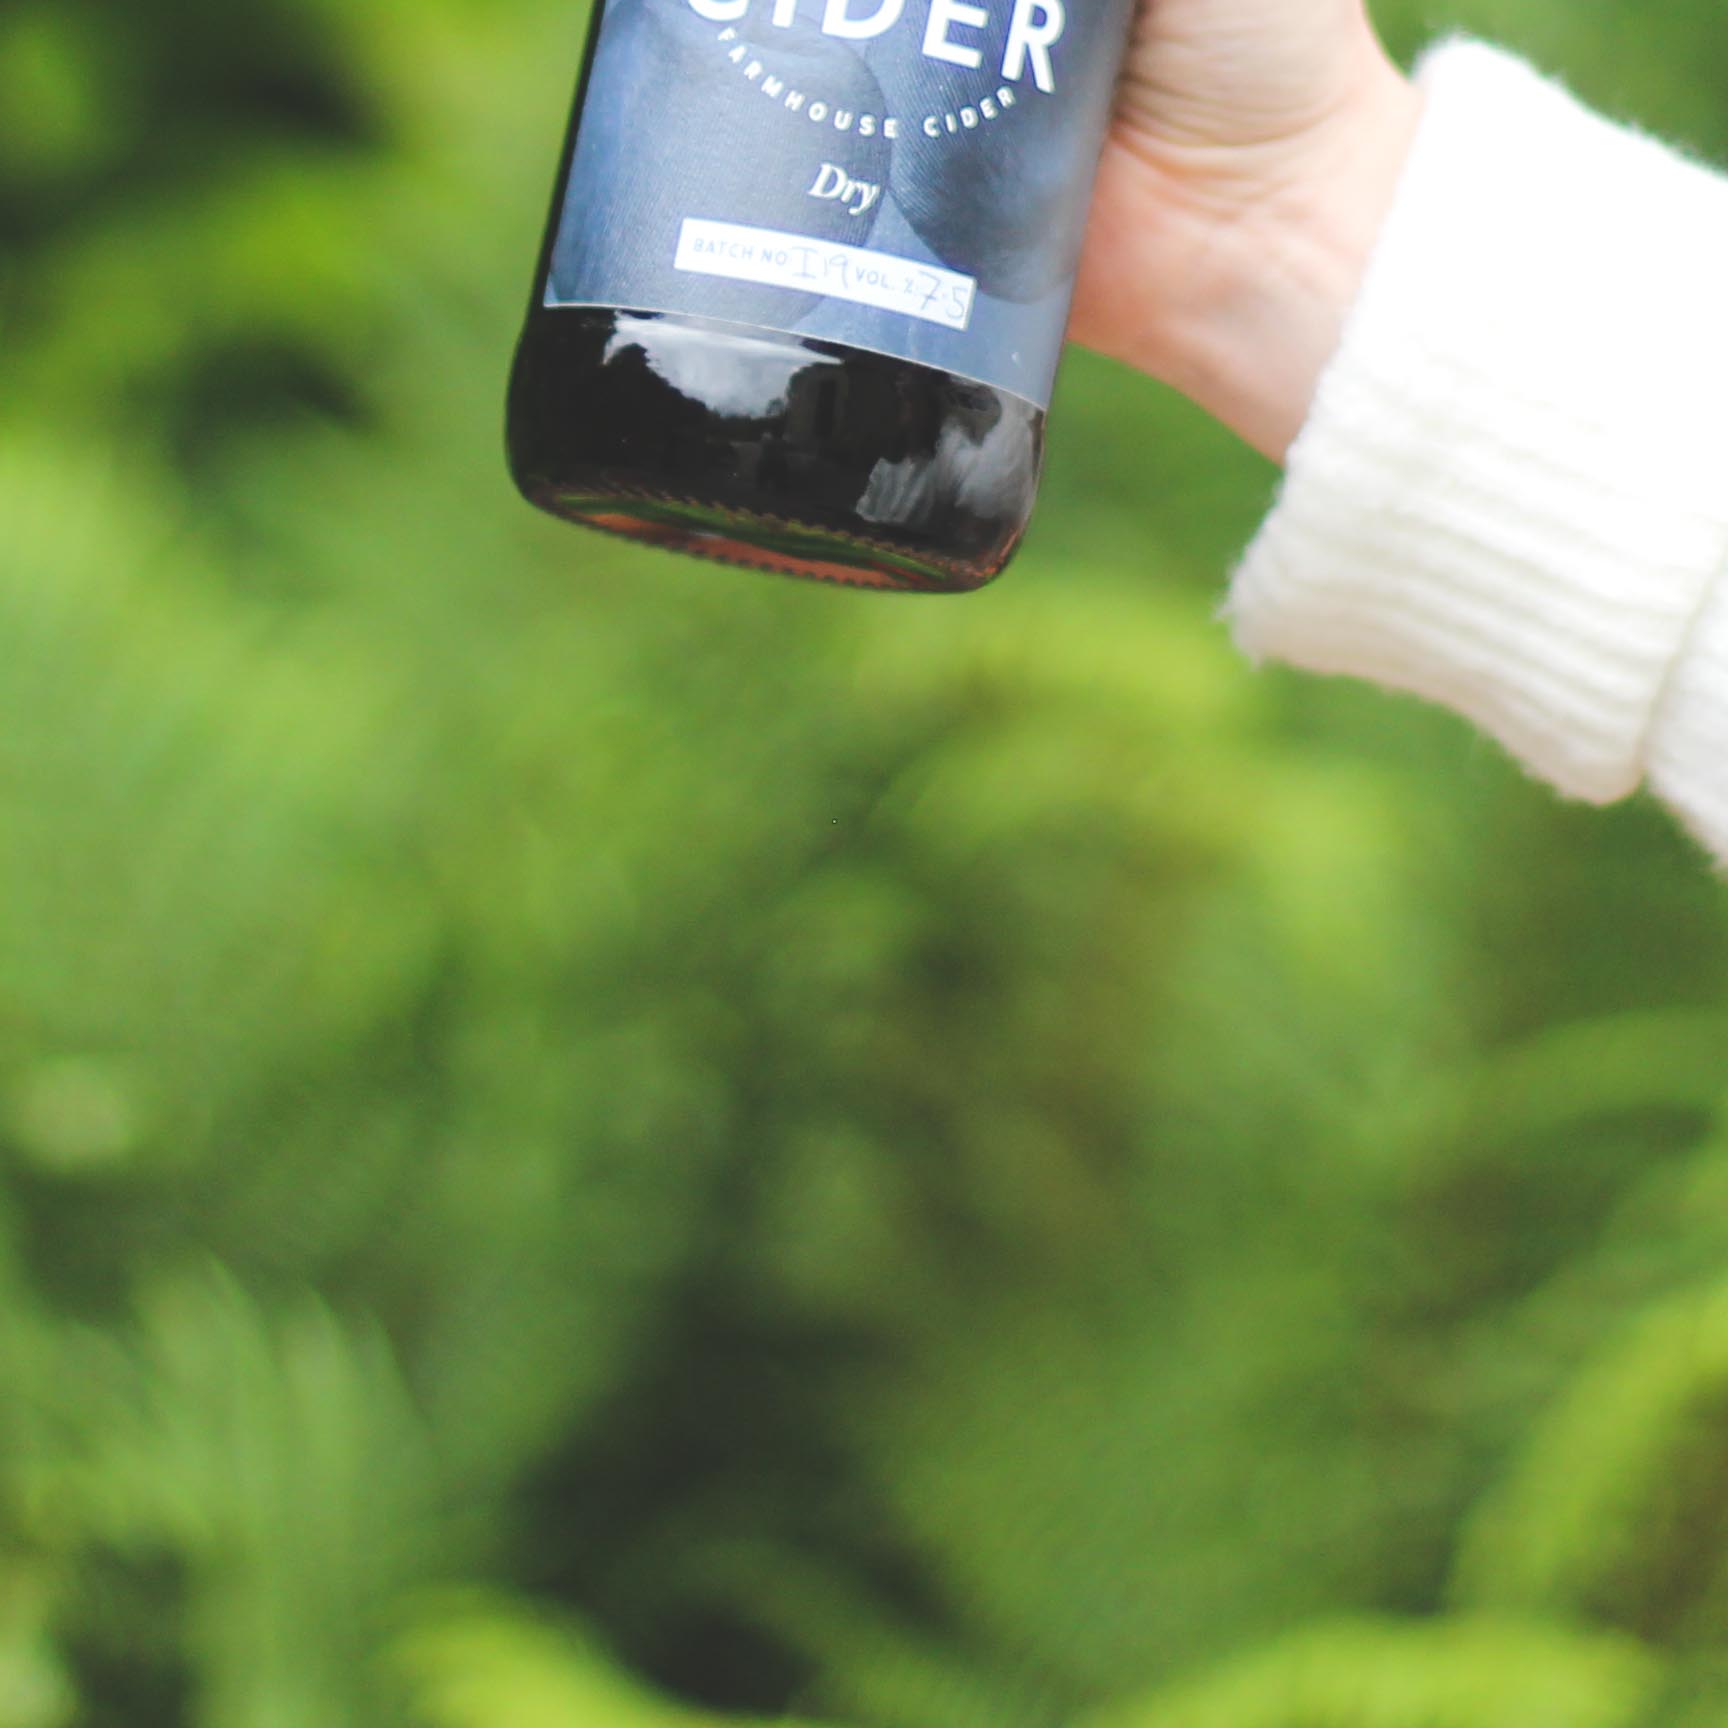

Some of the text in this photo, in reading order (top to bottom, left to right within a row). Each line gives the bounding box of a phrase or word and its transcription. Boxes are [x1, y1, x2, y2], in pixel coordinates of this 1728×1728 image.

[717, 27, 1016, 138] FARMHOUSE CIDER
[809, 163, 881, 215] Dry
[692, 238, 754, 260] BATCH
[760, 249, 789, 267] NO
